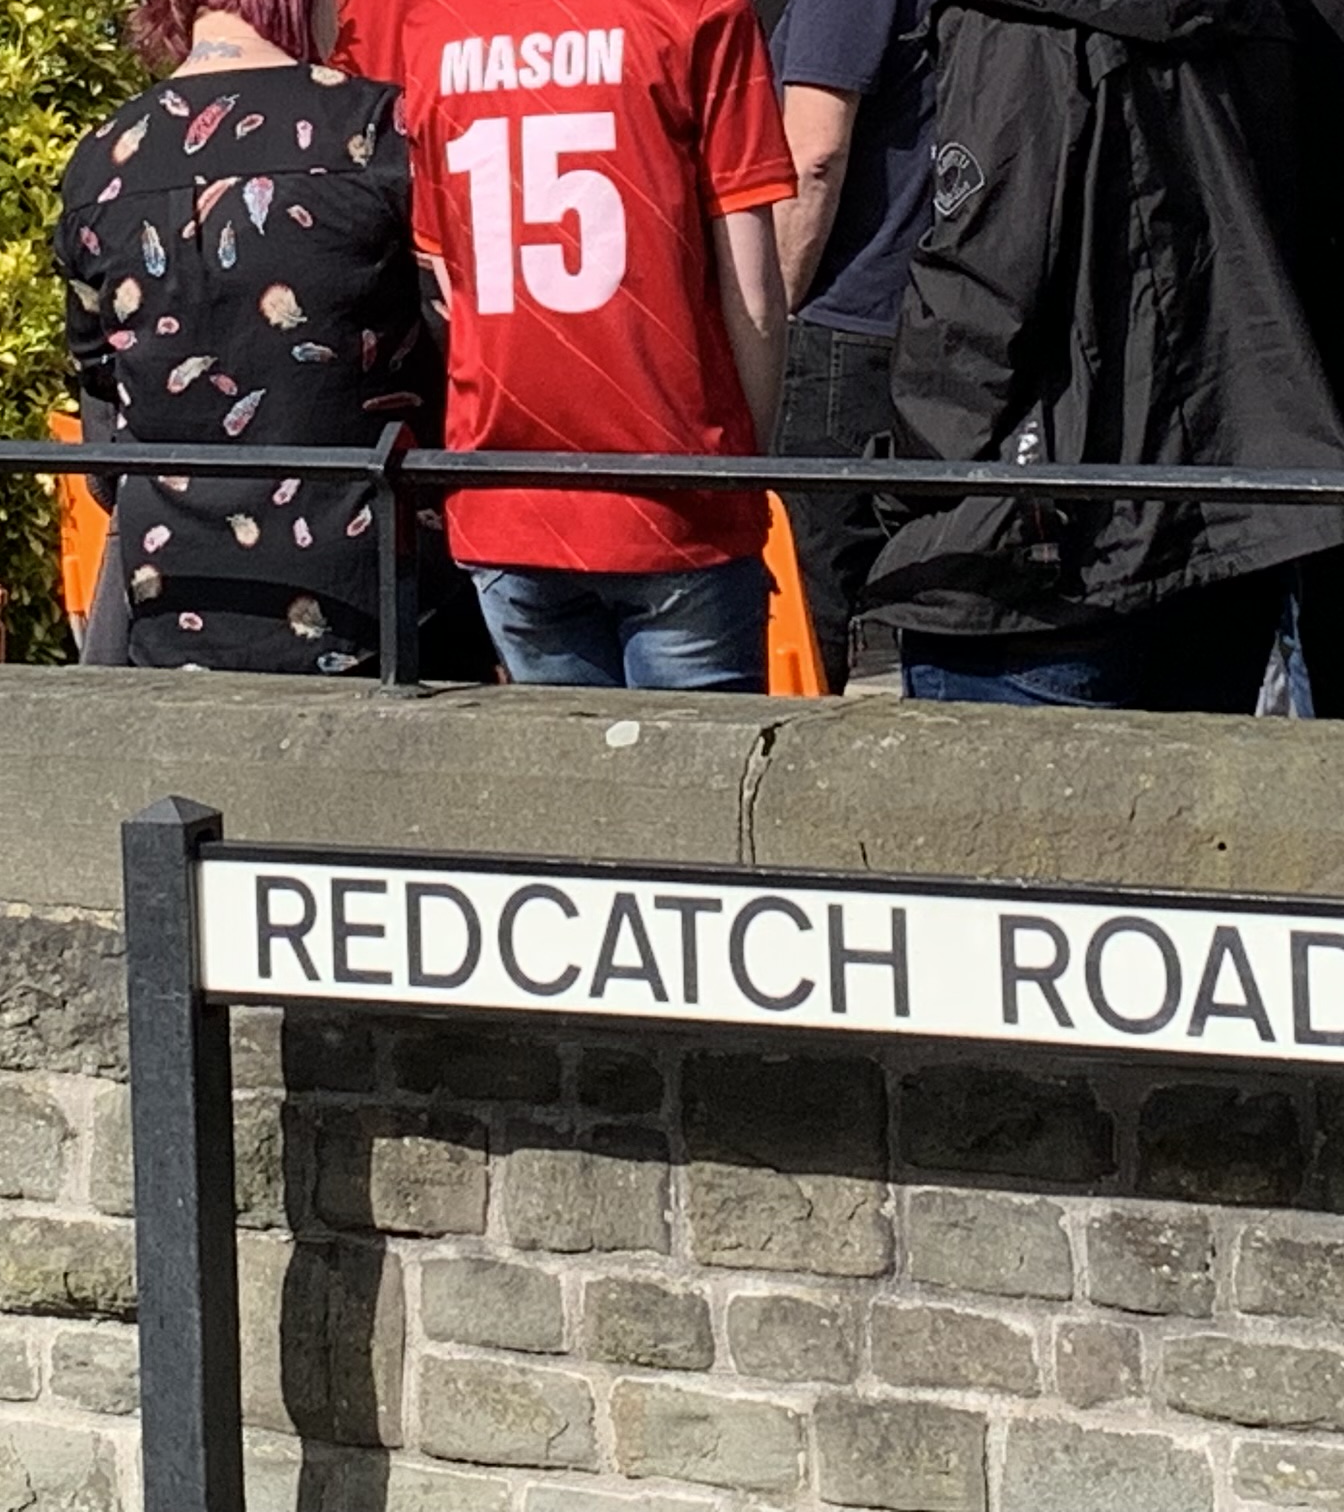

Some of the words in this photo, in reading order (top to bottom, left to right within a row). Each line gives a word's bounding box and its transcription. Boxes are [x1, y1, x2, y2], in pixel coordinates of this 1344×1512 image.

[440, 28, 624, 96] MASON
[445, 111, 627, 316] 15
[255, 874, 910, 1018] REDCATCH
